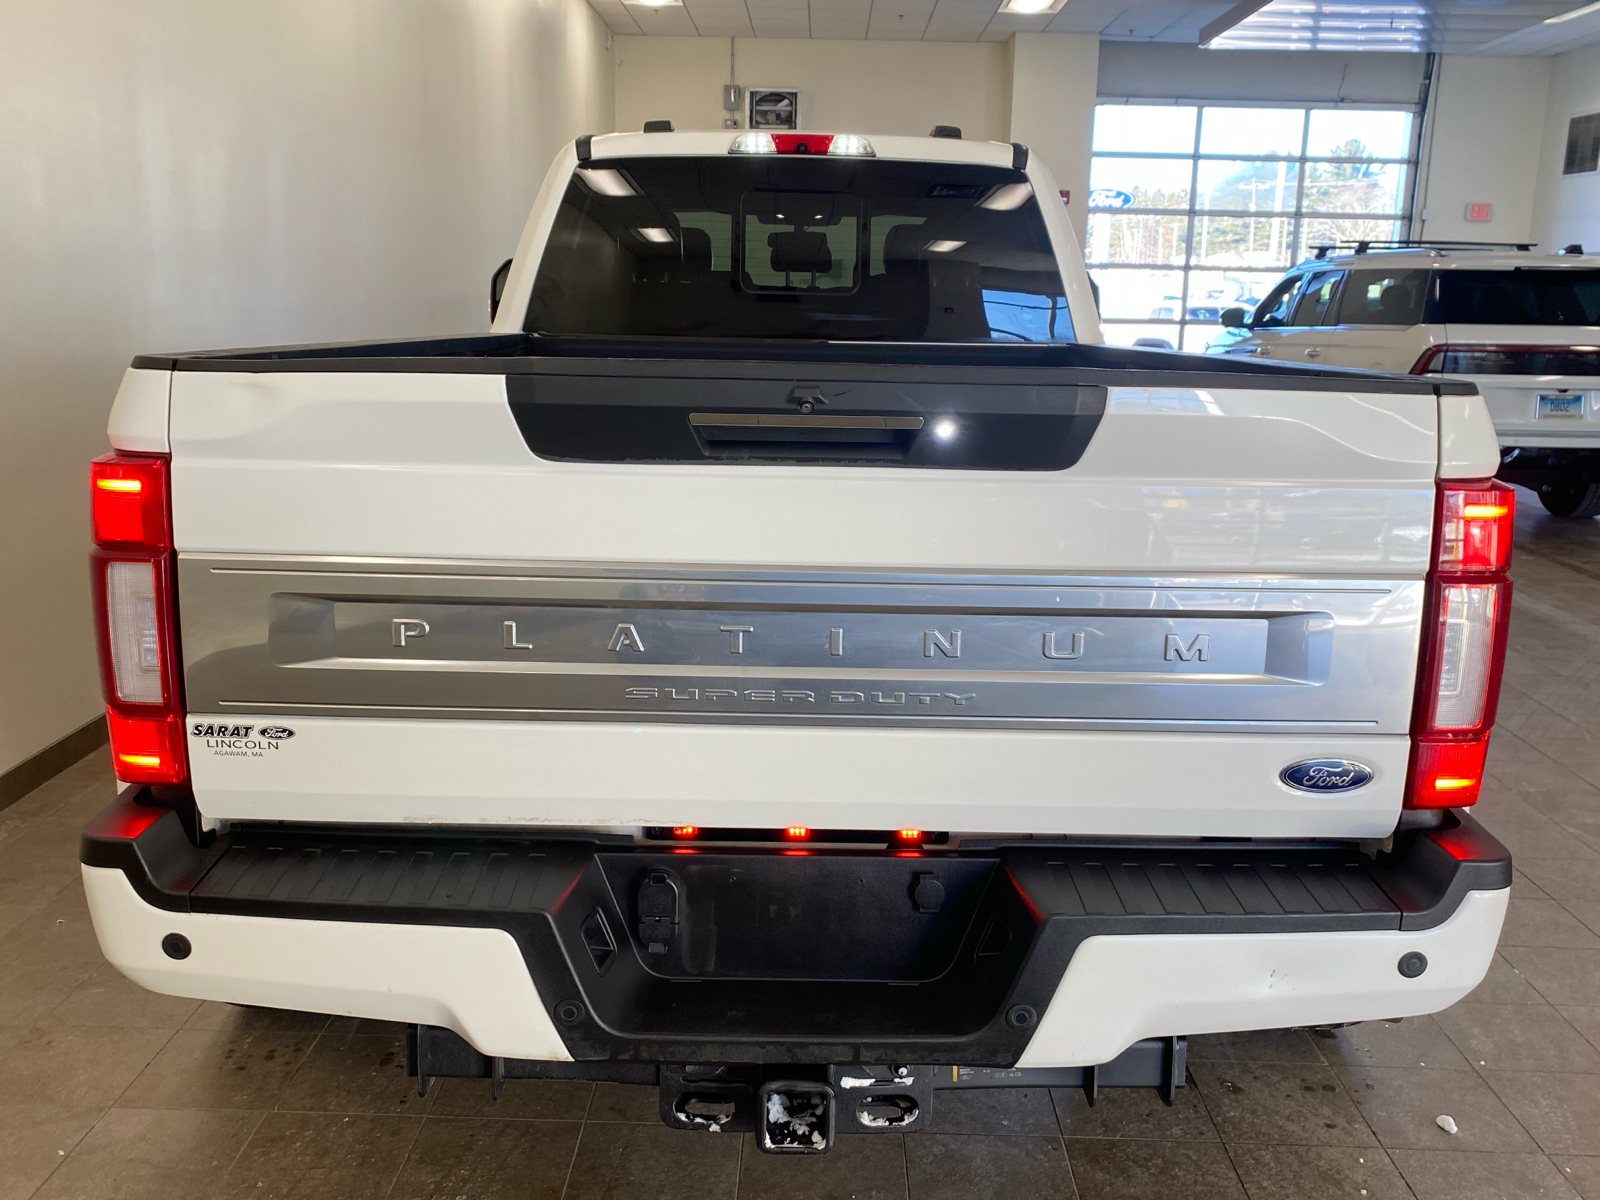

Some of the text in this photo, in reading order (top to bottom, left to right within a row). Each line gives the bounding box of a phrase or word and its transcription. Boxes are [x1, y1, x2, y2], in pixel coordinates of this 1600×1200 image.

[1089, 189, 1125, 208] Ford
[1470, 203, 1490, 219] EXIT
[391, 617, 1210, 662] PLATINUM
[625, 686, 976, 706] SUPER DUTY
[191, 723, 254, 739] SARAT
[206, 739, 279, 750] LINCOLN
